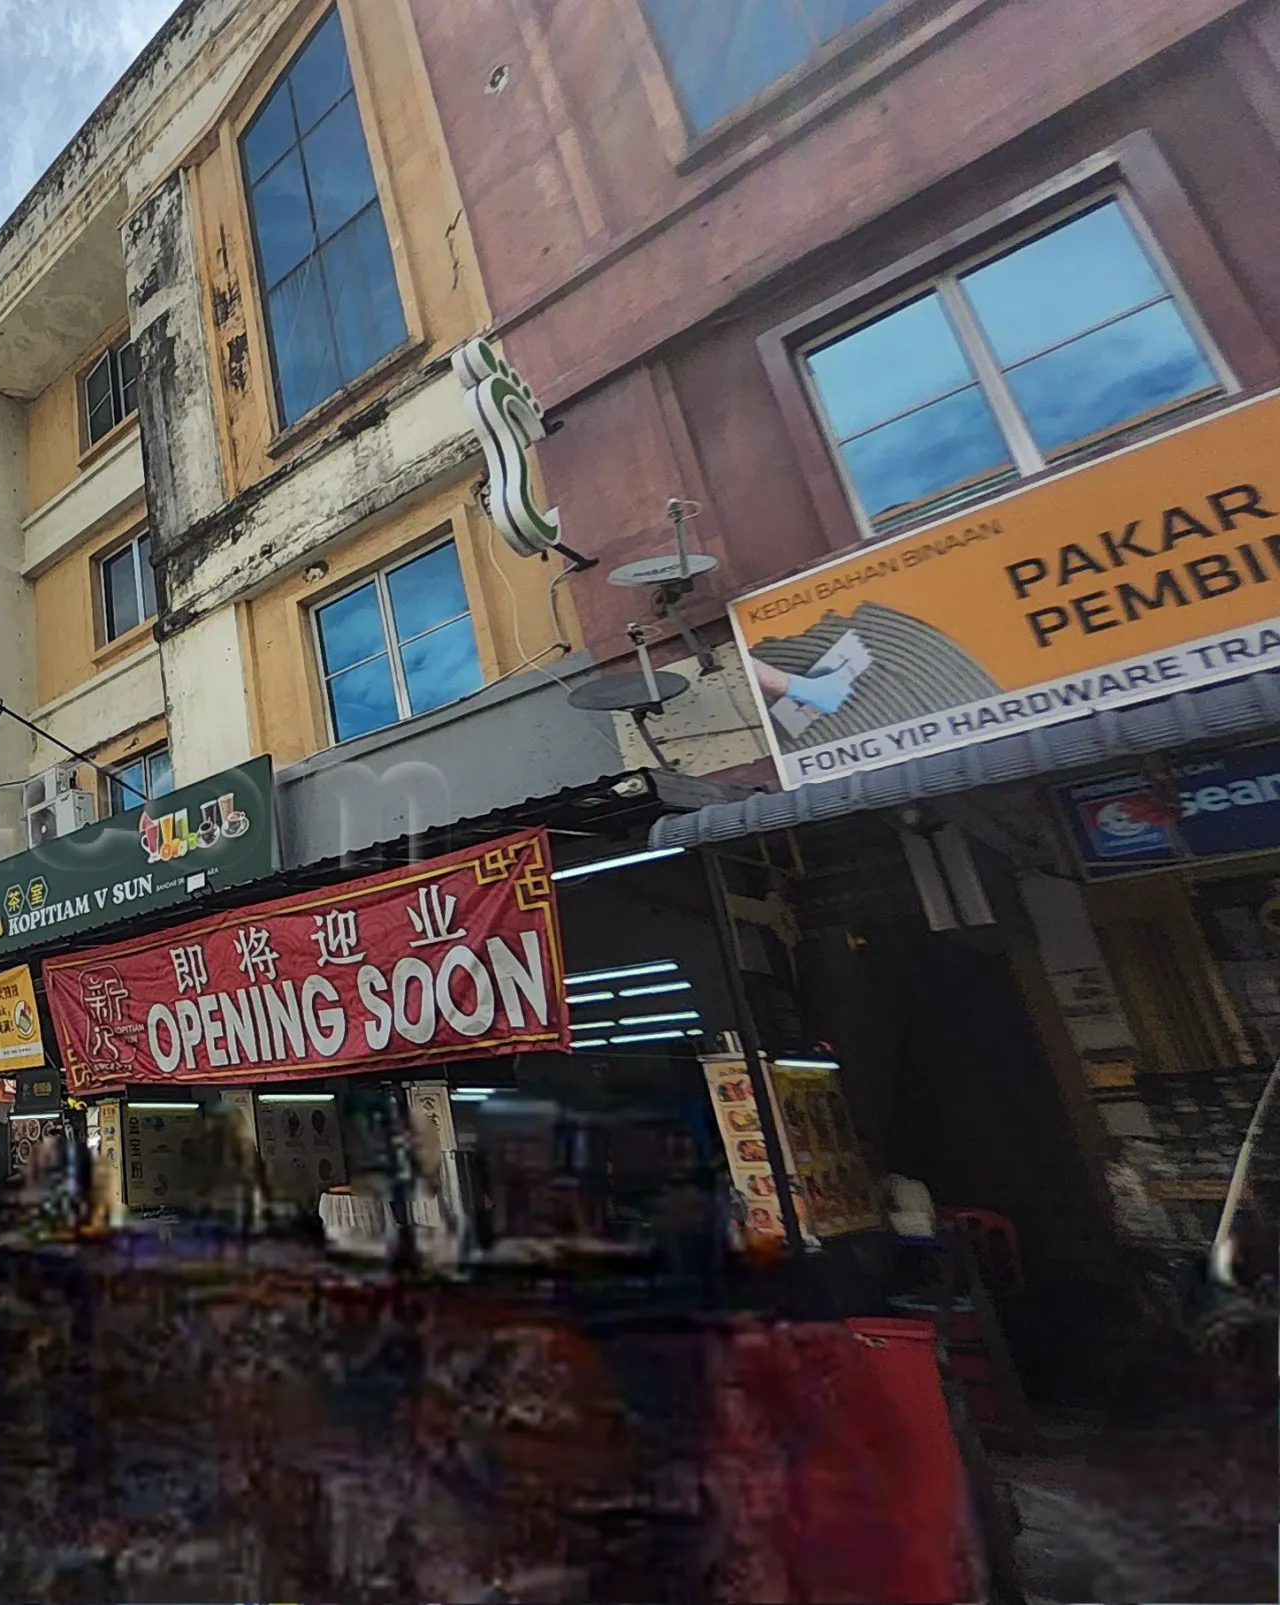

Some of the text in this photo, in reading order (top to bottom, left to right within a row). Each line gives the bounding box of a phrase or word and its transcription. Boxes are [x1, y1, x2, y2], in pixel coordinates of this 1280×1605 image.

[747, 519, 1004, 624] KEDAI BAHAN BINAAN
[1003, 483, 1278, 599] PAKAR
[797, 738, 882, 776] FONG
[885, 721, 942, 751] YIP
[946, 655, 1189, 736] HARDWARE
[8, 873, 153, 936] KOPITIAM V SUN
[147, 930, 549, 1073] OPENING SOON
